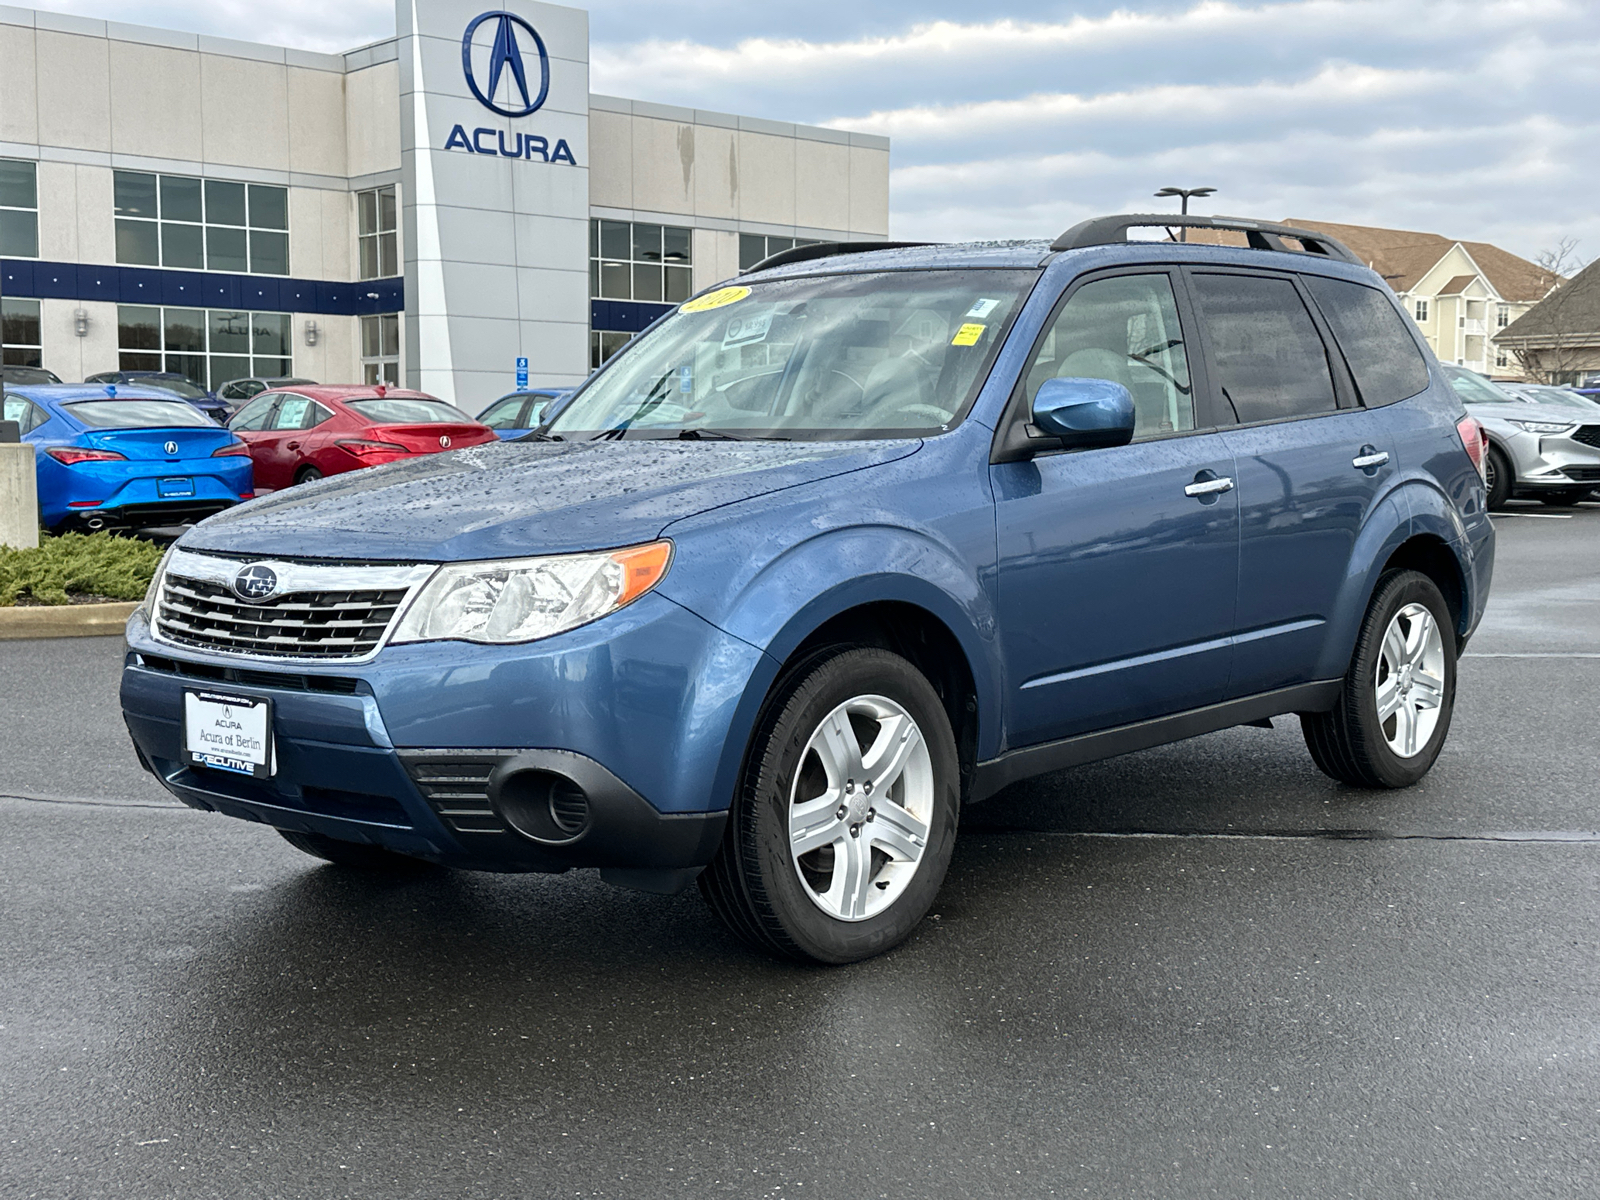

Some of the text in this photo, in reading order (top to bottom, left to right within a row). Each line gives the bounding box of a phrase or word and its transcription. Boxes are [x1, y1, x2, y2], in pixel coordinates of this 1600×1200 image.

[444, 124, 577, 165] ACURA
[215, 719, 242, 731] ACURA
[200, 729, 260, 750] Acura of Berlin
[192, 752, 255, 771] EXECUTIVE
